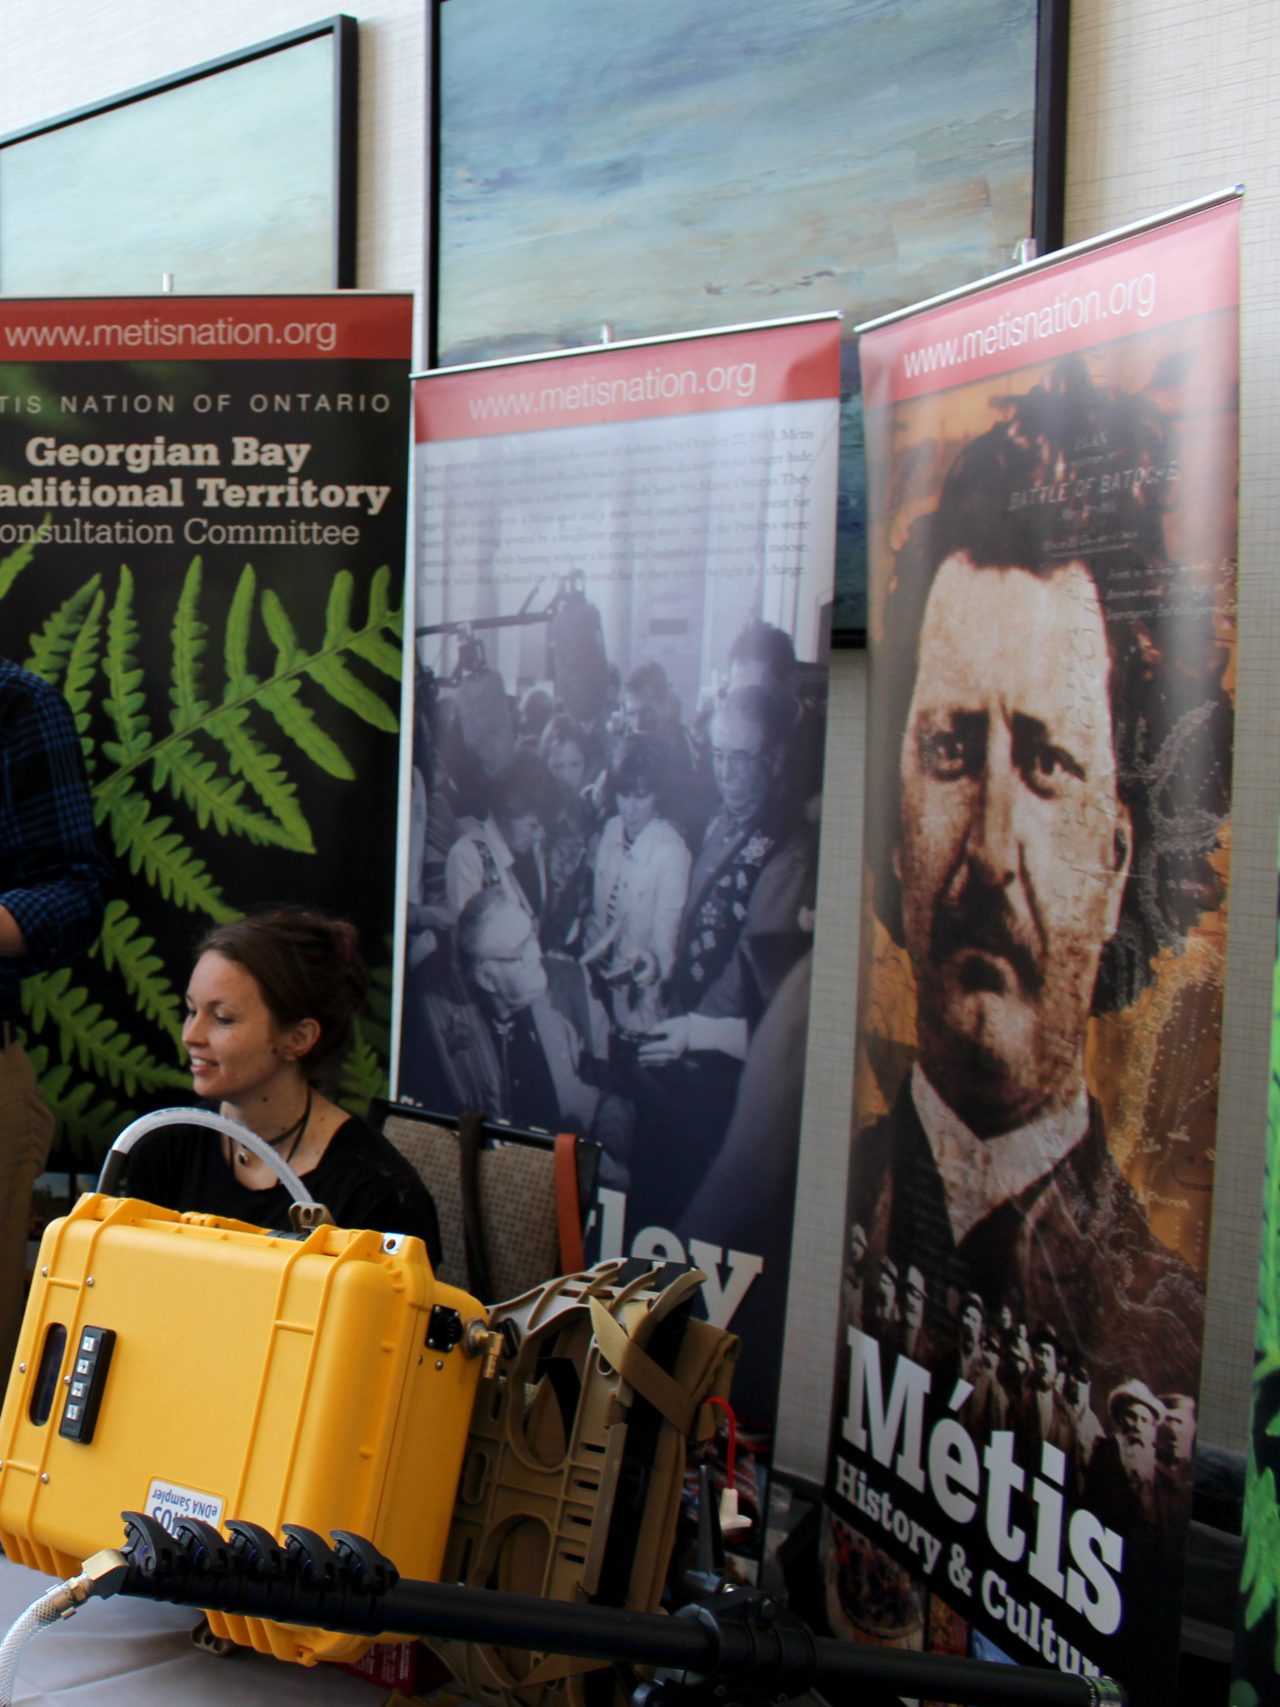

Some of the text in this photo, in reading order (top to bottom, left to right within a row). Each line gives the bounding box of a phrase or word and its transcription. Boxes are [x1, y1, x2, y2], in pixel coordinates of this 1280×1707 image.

[4, 318, 338, 350] www.metisnation.org
[903, 271, 1157, 379] www.metisnation.org
[61, 394, 175, 413] NATION
[193, 394, 232, 412] OF
[250, 393, 391, 412] ONTARIO
[467, 361, 757, 421] www.metisnation.org
[25, 436, 312, 473] Georgian Bay
[197, 478, 391, 515] Territory
[1074, 477, 1096, 498] OF
[183, 517, 360, 545] Committee
[842, 1324, 1124, 1636] Métis
[151, 1488, 217, 1518] eDNA Sampler
[835, 1455, 1113, 1679] History & Cultur
